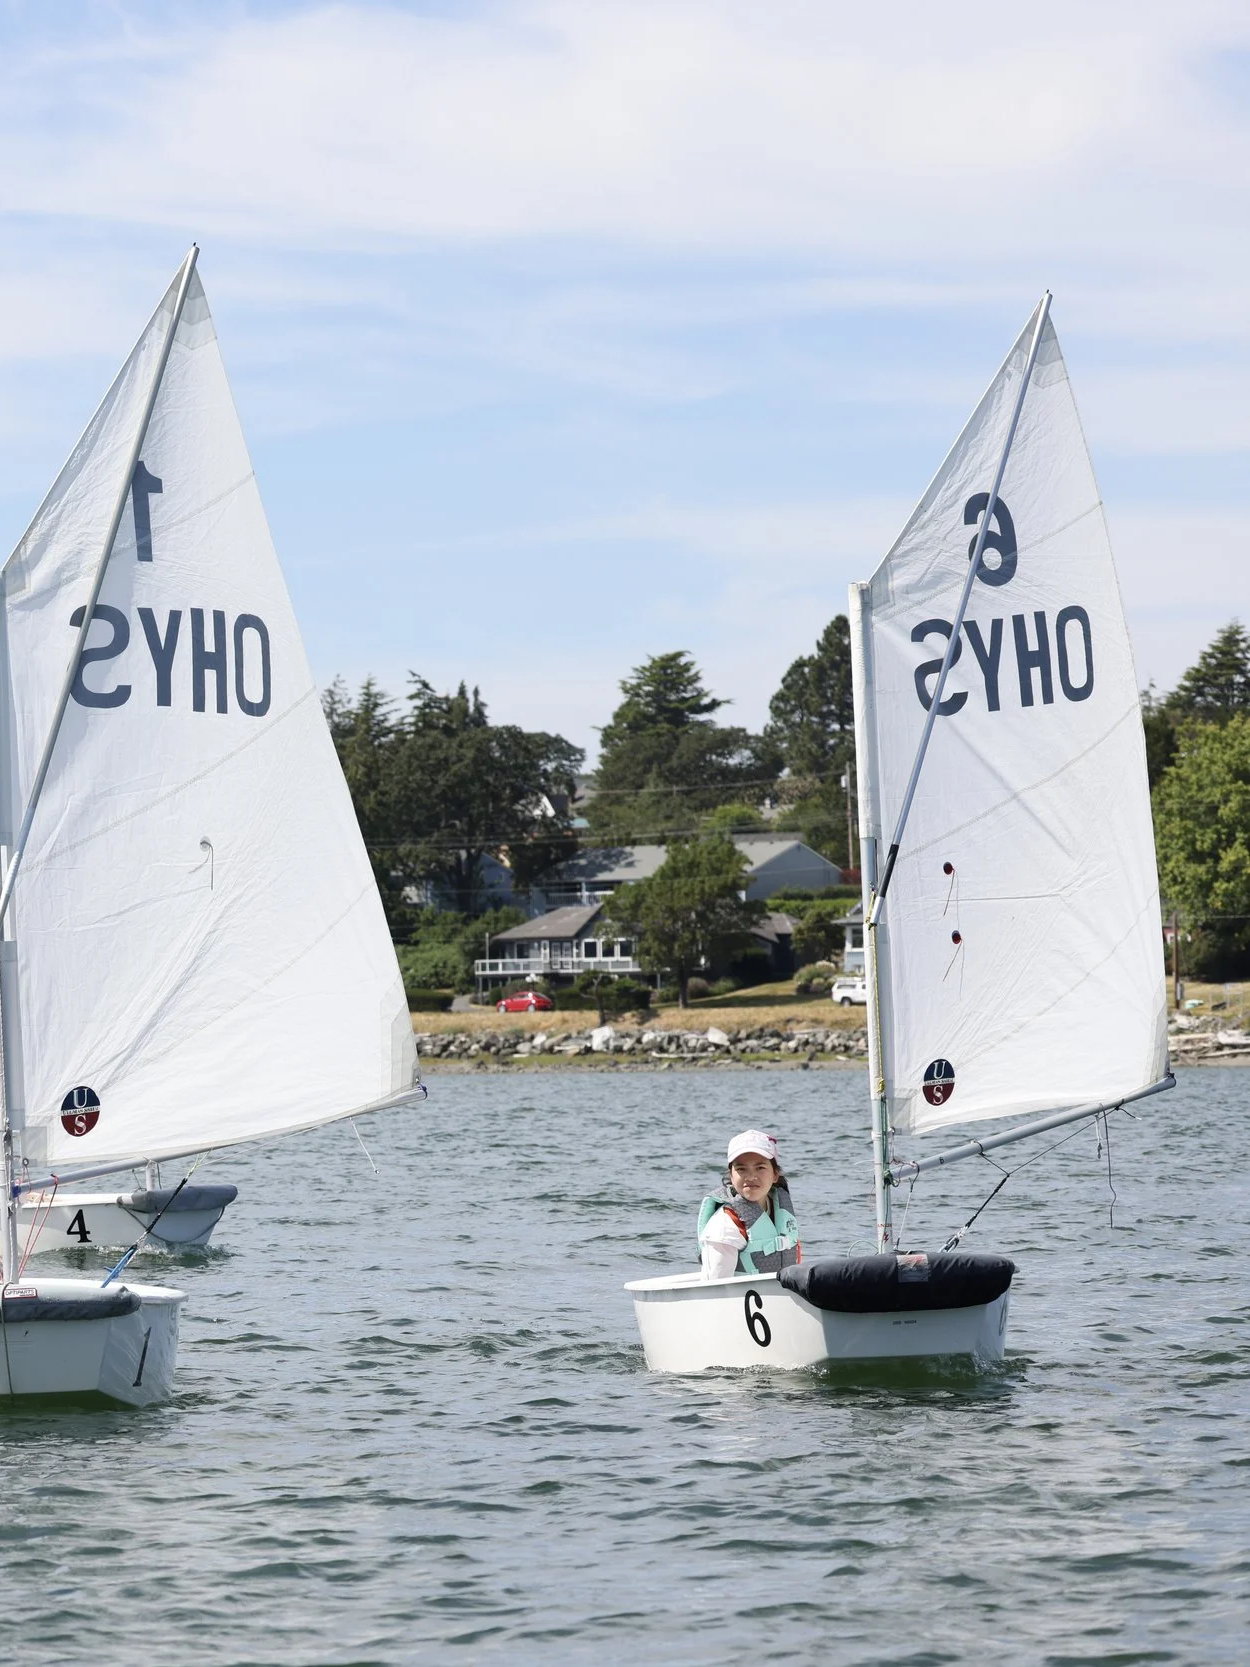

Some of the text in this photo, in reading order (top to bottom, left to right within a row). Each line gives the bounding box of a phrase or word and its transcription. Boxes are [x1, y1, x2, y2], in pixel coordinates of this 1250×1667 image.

[66, 1208, 92, 1244] 4
[744, 1289, 772, 1348] 6
[133, 1326, 152, 1387] 1
